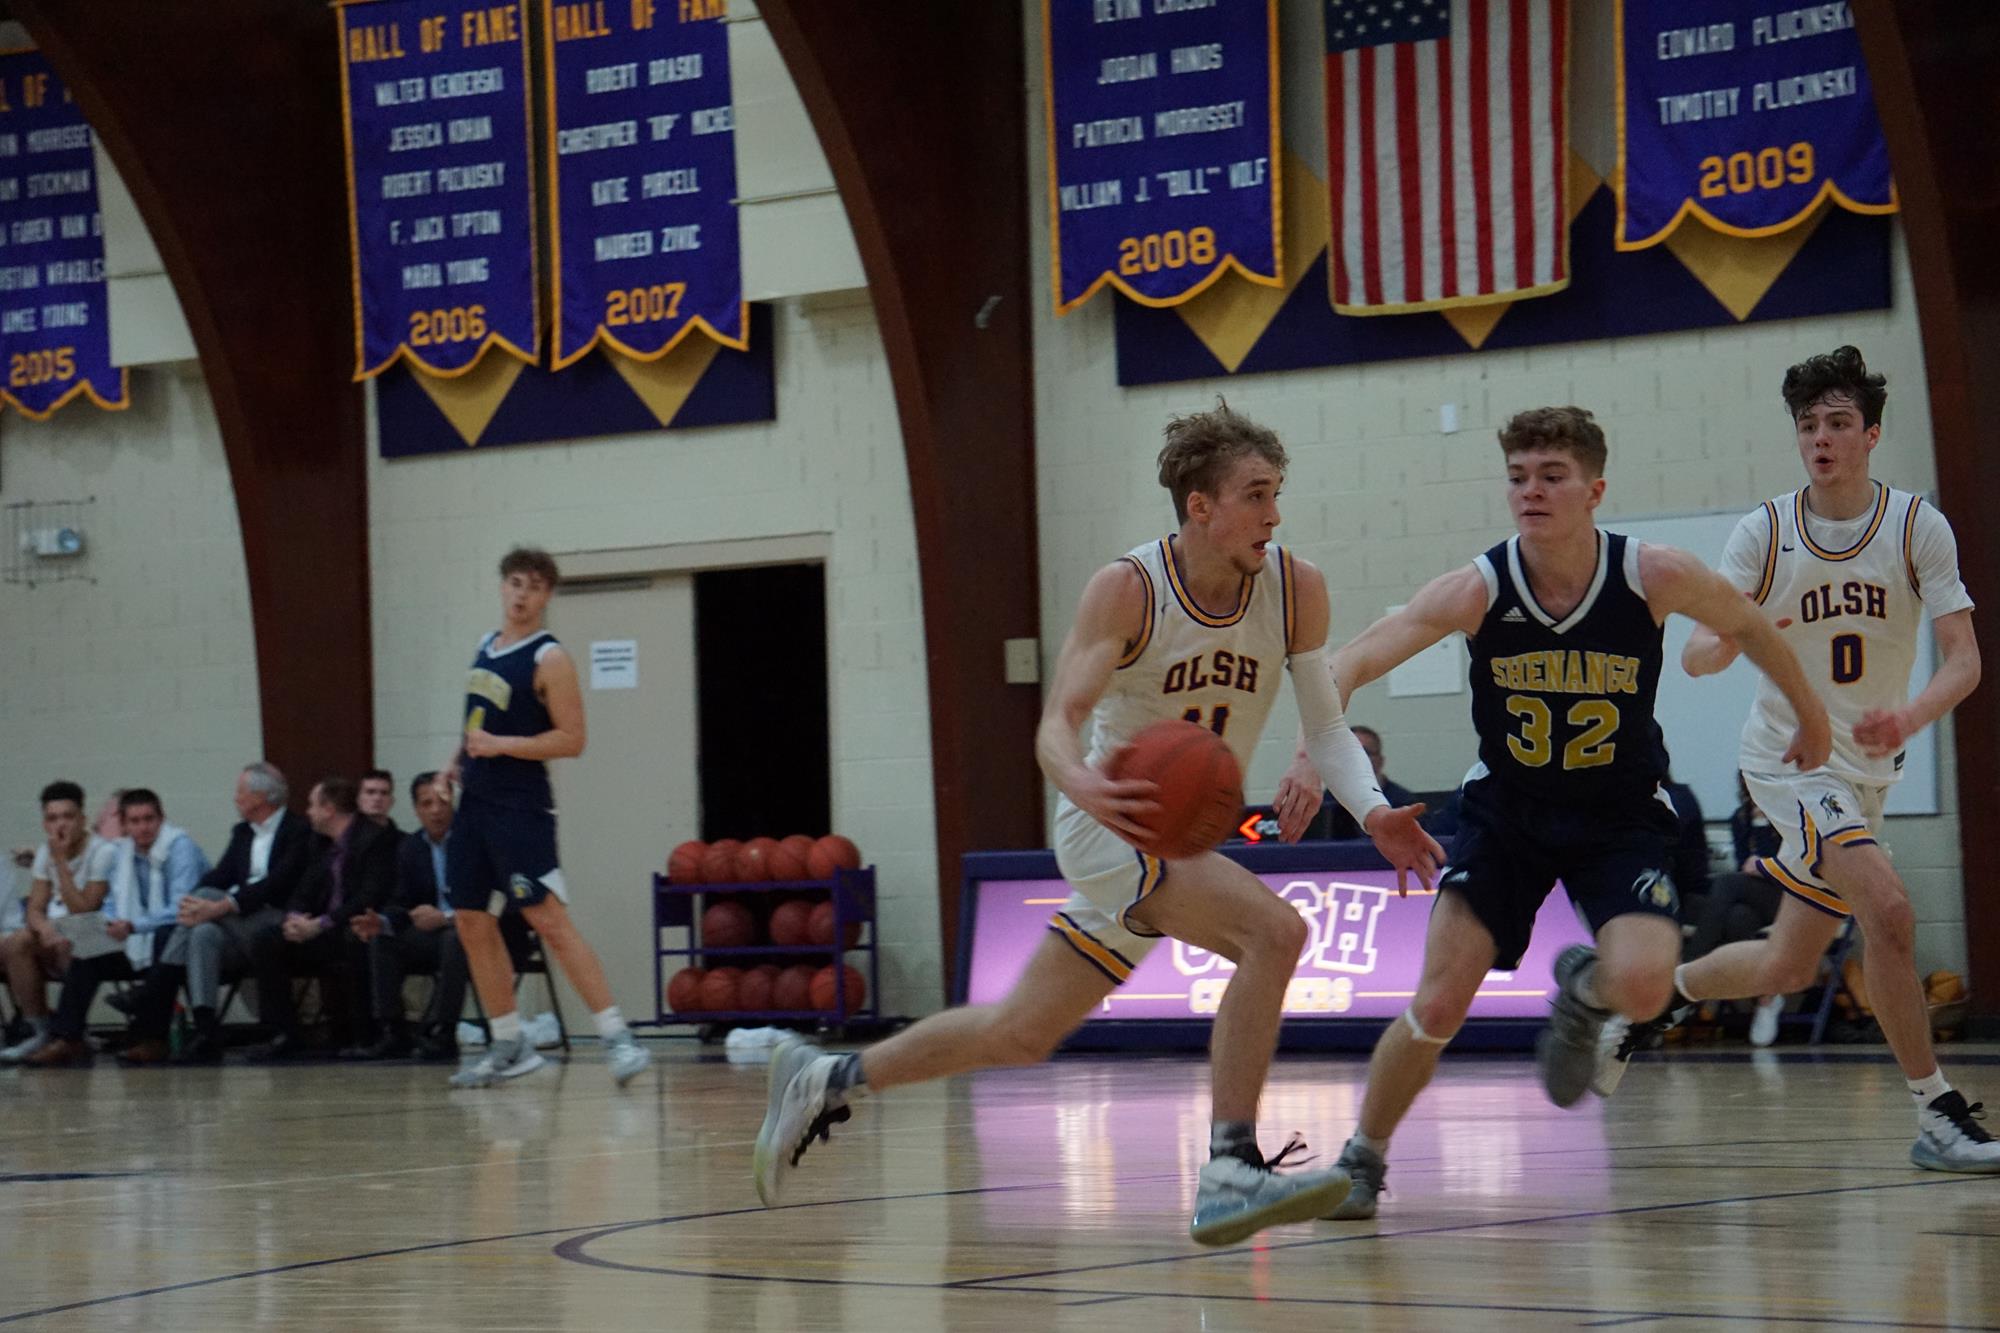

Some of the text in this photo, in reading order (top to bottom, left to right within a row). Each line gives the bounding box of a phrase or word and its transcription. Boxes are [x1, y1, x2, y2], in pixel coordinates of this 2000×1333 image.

[349, 5, 519, 63] HALL OF FAME
[555, 2, 612, 42] HALL
[630, 0, 656, 31] OF
[1657, 22, 1735, 61] EDWARD
[1657, 86, 1741, 126] TIMOTHY
[389, 122, 443, 152] JESSICA
[1073, 116, 1144, 149] PATRICIA
[1699, 141, 1815, 199] 2009
[1119, 226, 1217, 276] 2008
[409, 304, 487, 347] 2006
[606, 282, 687, 326] 2007
[10, 347, 75, 386] 2005
[1800, 581, 1887, 623] OLSH
[1163, 650, 1258, 694] OLSH
[1490, 650, 1641, 694] SHENANGO
[1831, 632, 1865, 684] 0
[1506, 694, 1620, 771] 32
